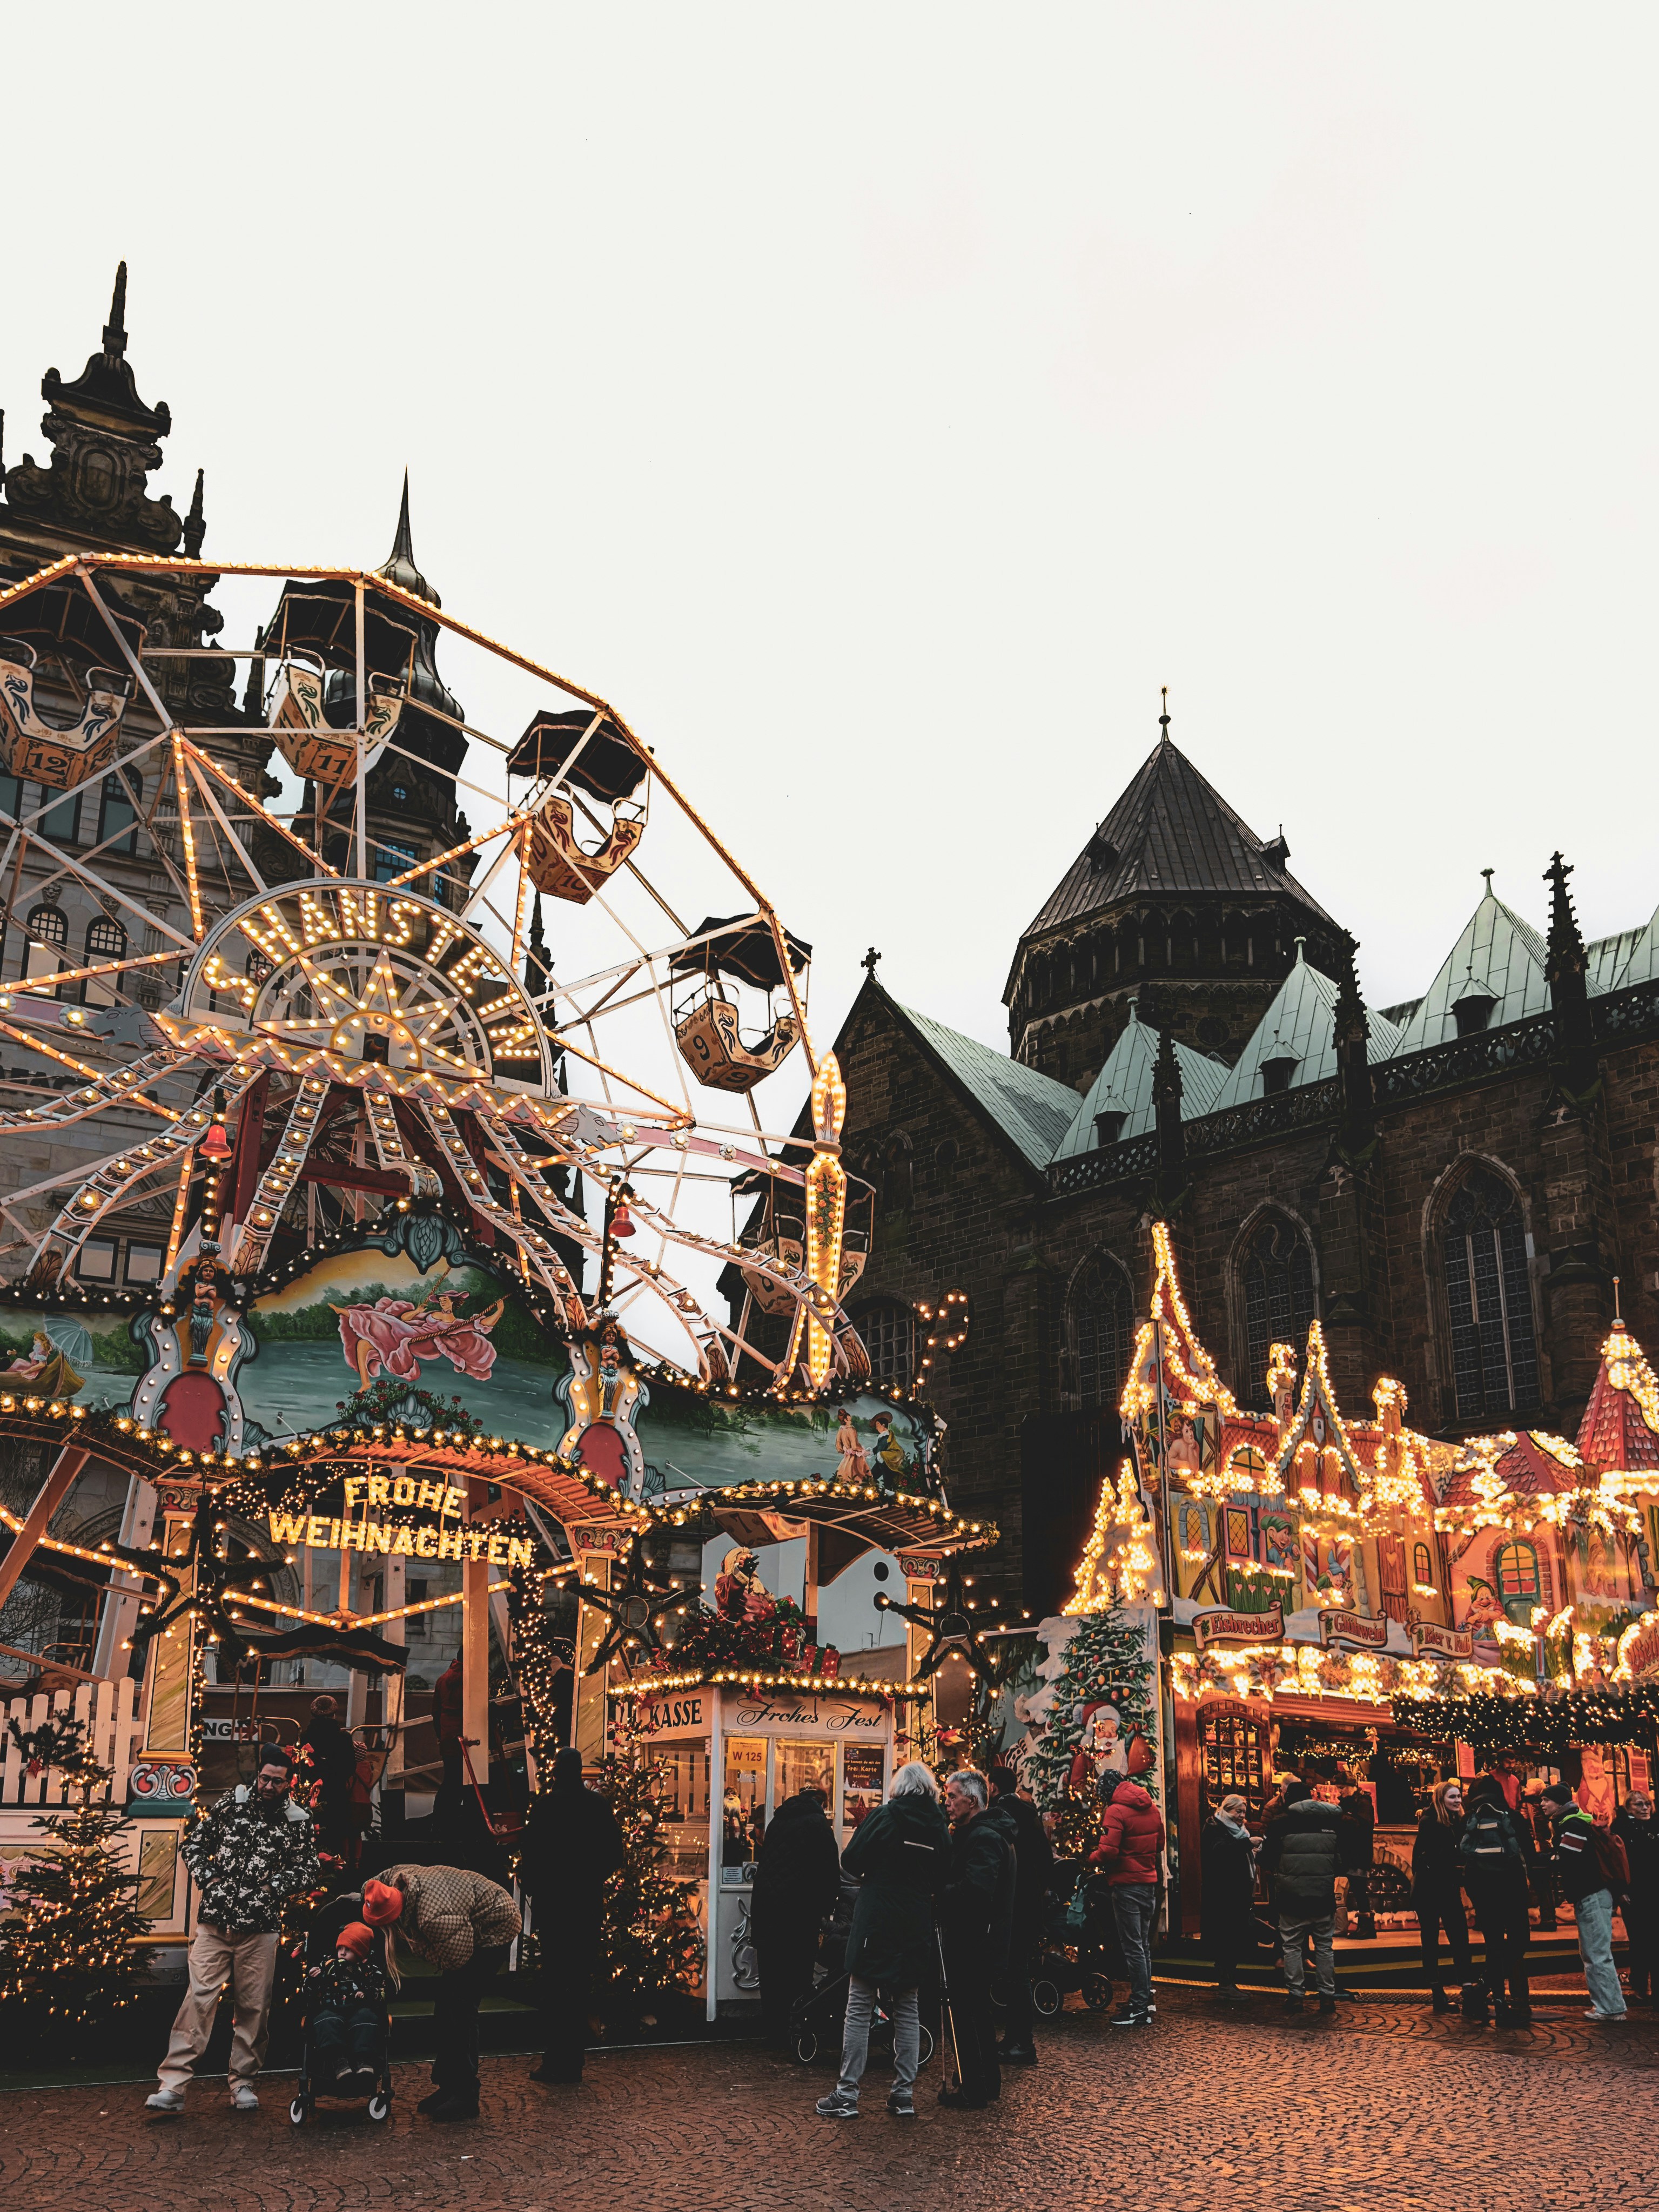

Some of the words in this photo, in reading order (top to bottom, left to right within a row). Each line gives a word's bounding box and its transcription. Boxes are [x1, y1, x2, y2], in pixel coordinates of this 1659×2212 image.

[30, 752, 68, 776] 12
[318, 755, 348, 775] 11
[238, 889, 541, 1060] HANSTEIN
[693, 1035, 710, 1061] 9
[726, 1071, 750, 1083] 9
[344, 1476, 468, 1518] FROHE
[268, 1512, 533, 1568] WEIHNACHTEN
[1210, 1613, 1279, 1635] Eisbrecher
[1334, 1613, 1385, 1641] Glühwein
[1424, 1625, 1444, 1646] Bier
[1446, 1637, 1453, 1651] v.
[650, 1699, 702, 1729] KASSE
[737, 1698, 819, 1726] Frohes
[826, 1703, 882, 1730] Fest
[203, 1722, 232, 1736] NG
[733, 1751, 742, 1760] W
[745, 1752, 762, 1761] 125
